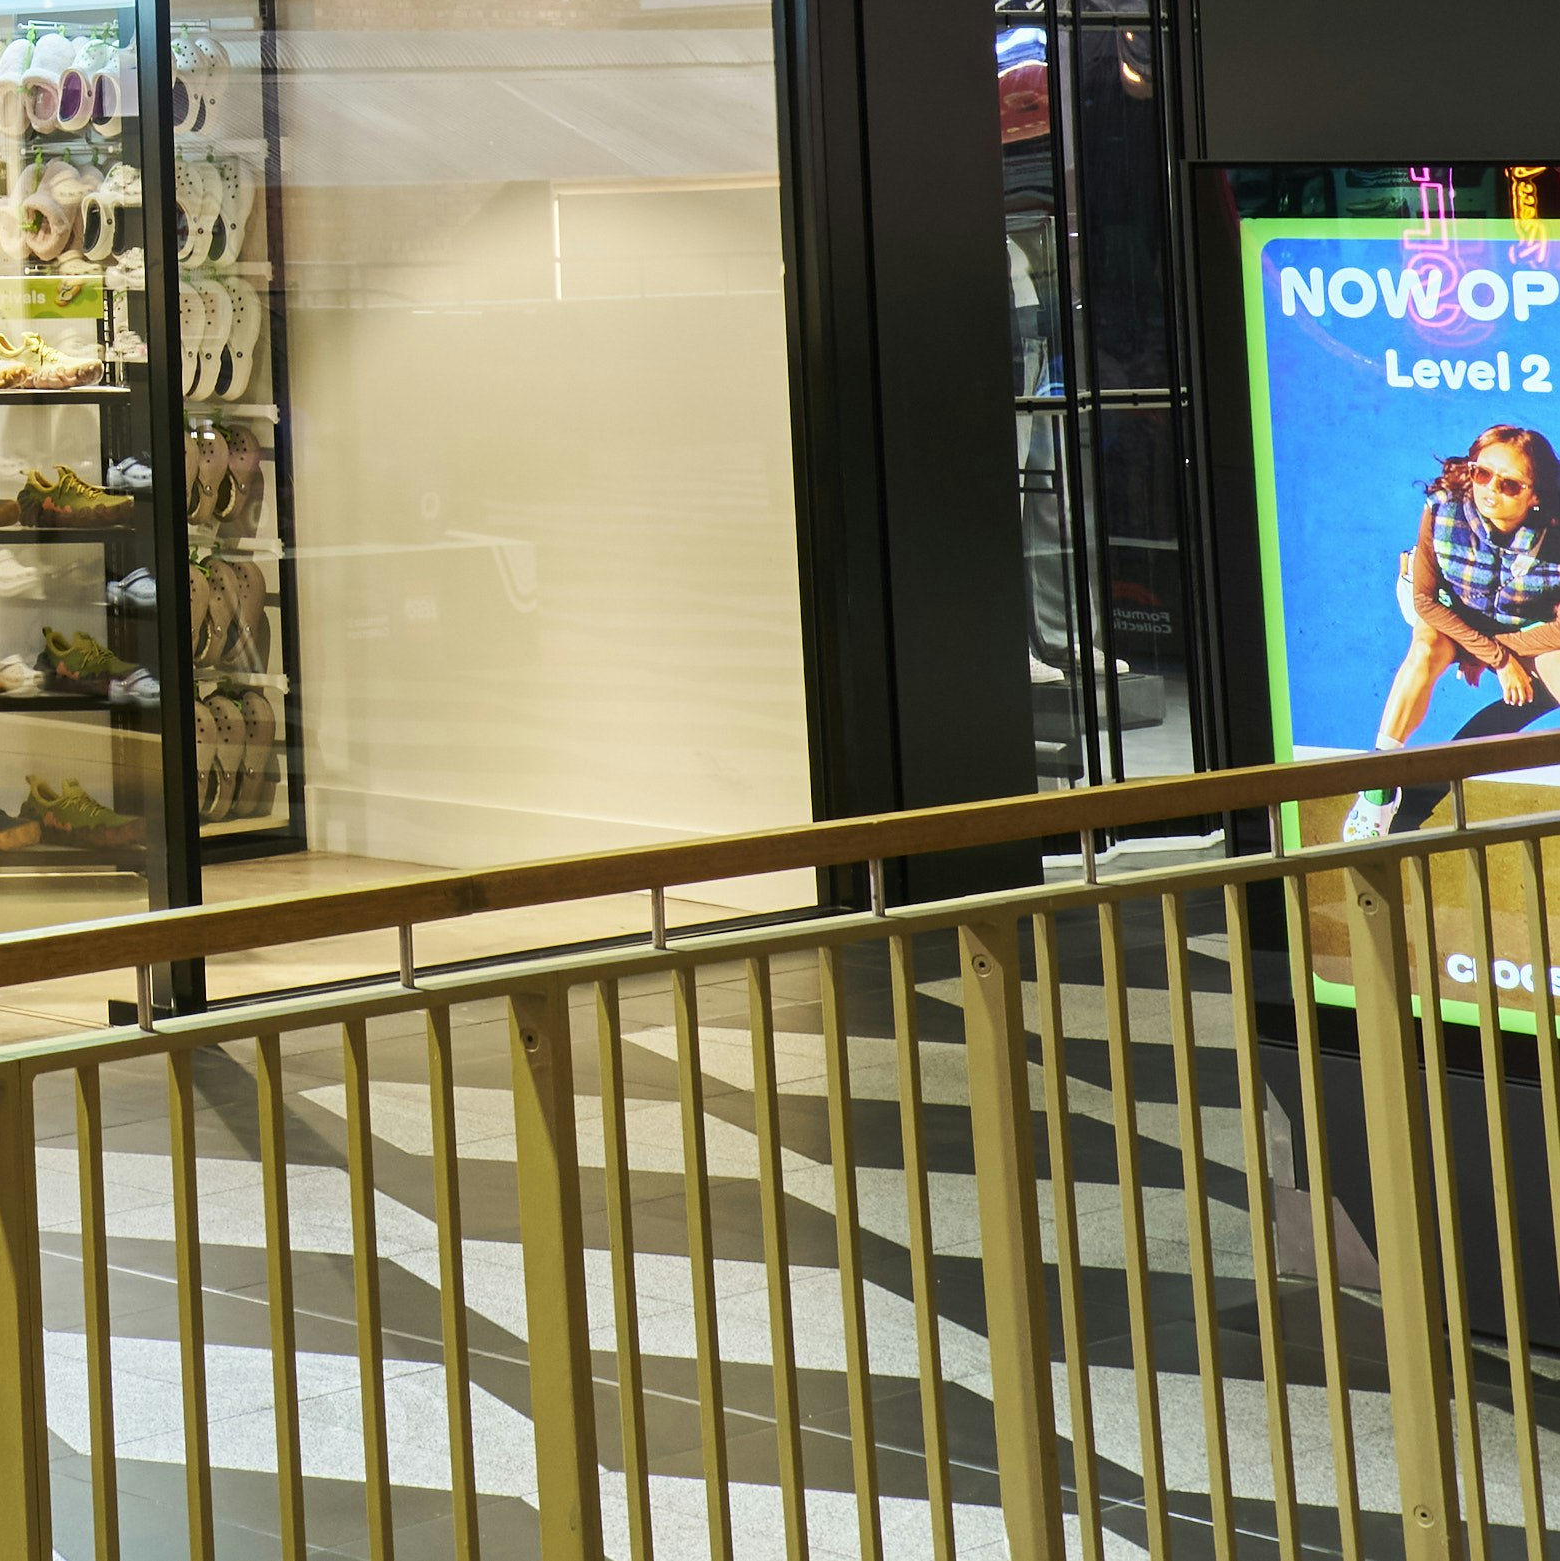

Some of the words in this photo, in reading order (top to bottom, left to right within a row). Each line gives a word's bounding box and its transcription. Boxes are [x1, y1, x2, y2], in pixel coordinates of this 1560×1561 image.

[1280, 266, 1443, 320] NOW
[1385, 349, 1511, 392] Level
[1520, 354, 1553, 393] 2
